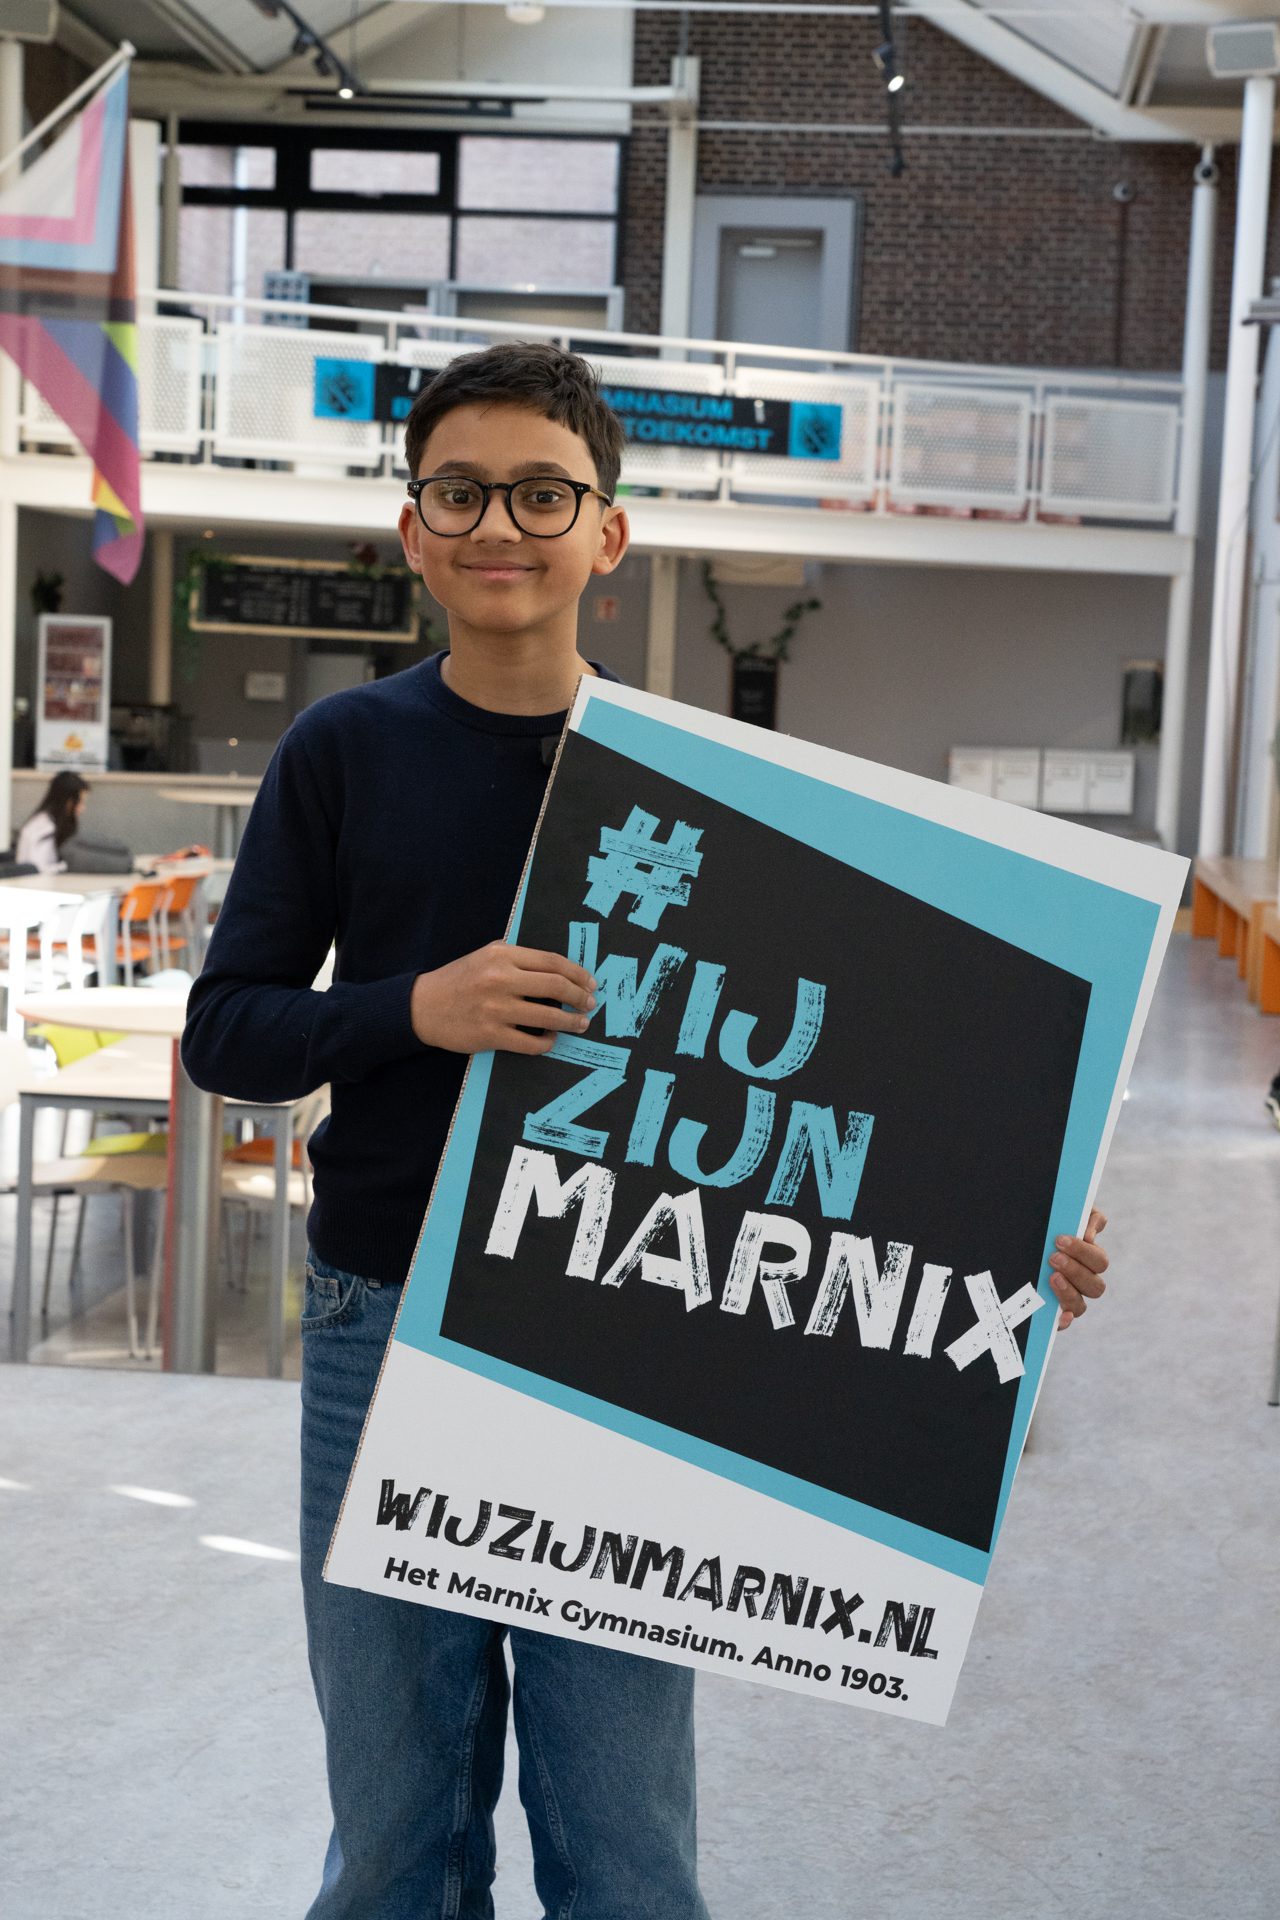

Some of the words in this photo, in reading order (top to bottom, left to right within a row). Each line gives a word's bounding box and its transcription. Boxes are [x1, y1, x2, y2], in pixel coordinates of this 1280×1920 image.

[582, 805, 704, 931] #
[562, 921, 827, 1080] WIJ
[522, 1032, 875, 1221] ZIJN
[484, 1145, 1046, 1384] MARNIX
[376, 1479, 939, 1659] WIJZIJNMARNIX.NL
[384, 1556, 440, 1590] Het
[447, 1571, 553, 1617] Marnix
[561, 1600, 744, 1662] Gymnasium.
[751, 1646, 832, 1682] Anno
[840, 1664, 909, 1702] 1903.
